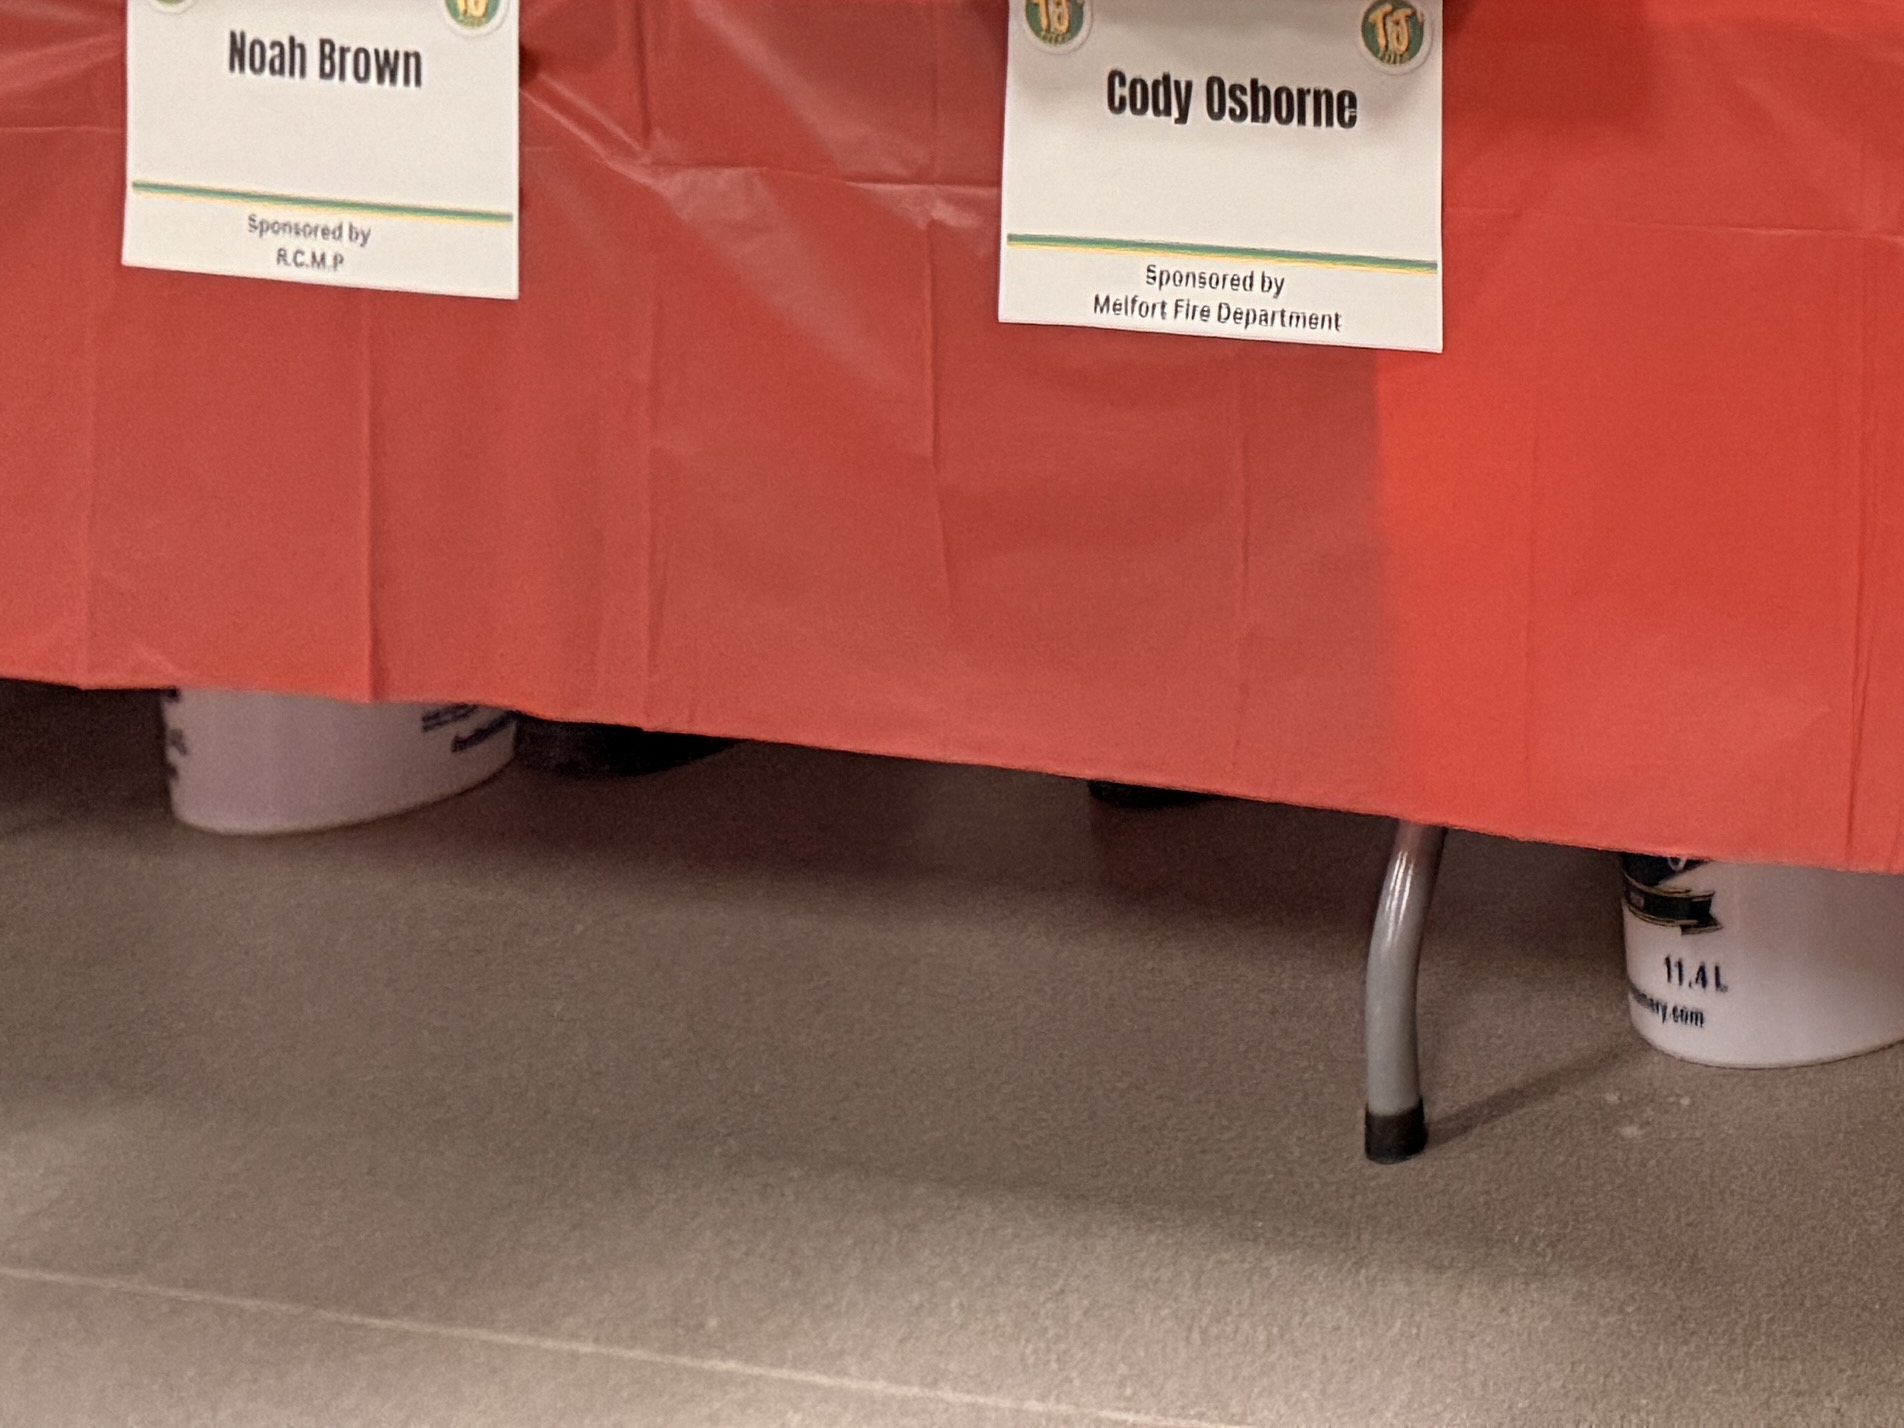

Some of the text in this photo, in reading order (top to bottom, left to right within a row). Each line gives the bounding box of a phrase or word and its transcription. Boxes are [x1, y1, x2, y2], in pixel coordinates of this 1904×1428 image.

[229, 30, 422, 89] Noah Brown
[1107, 69, 1357, 129] Cody Osborne
[249, 213, 372, 247] Sponsored by
[1146, 264, 1285, 299] Sponsored by
[1094, 293, 1342, 331] Melfort Fire Department
